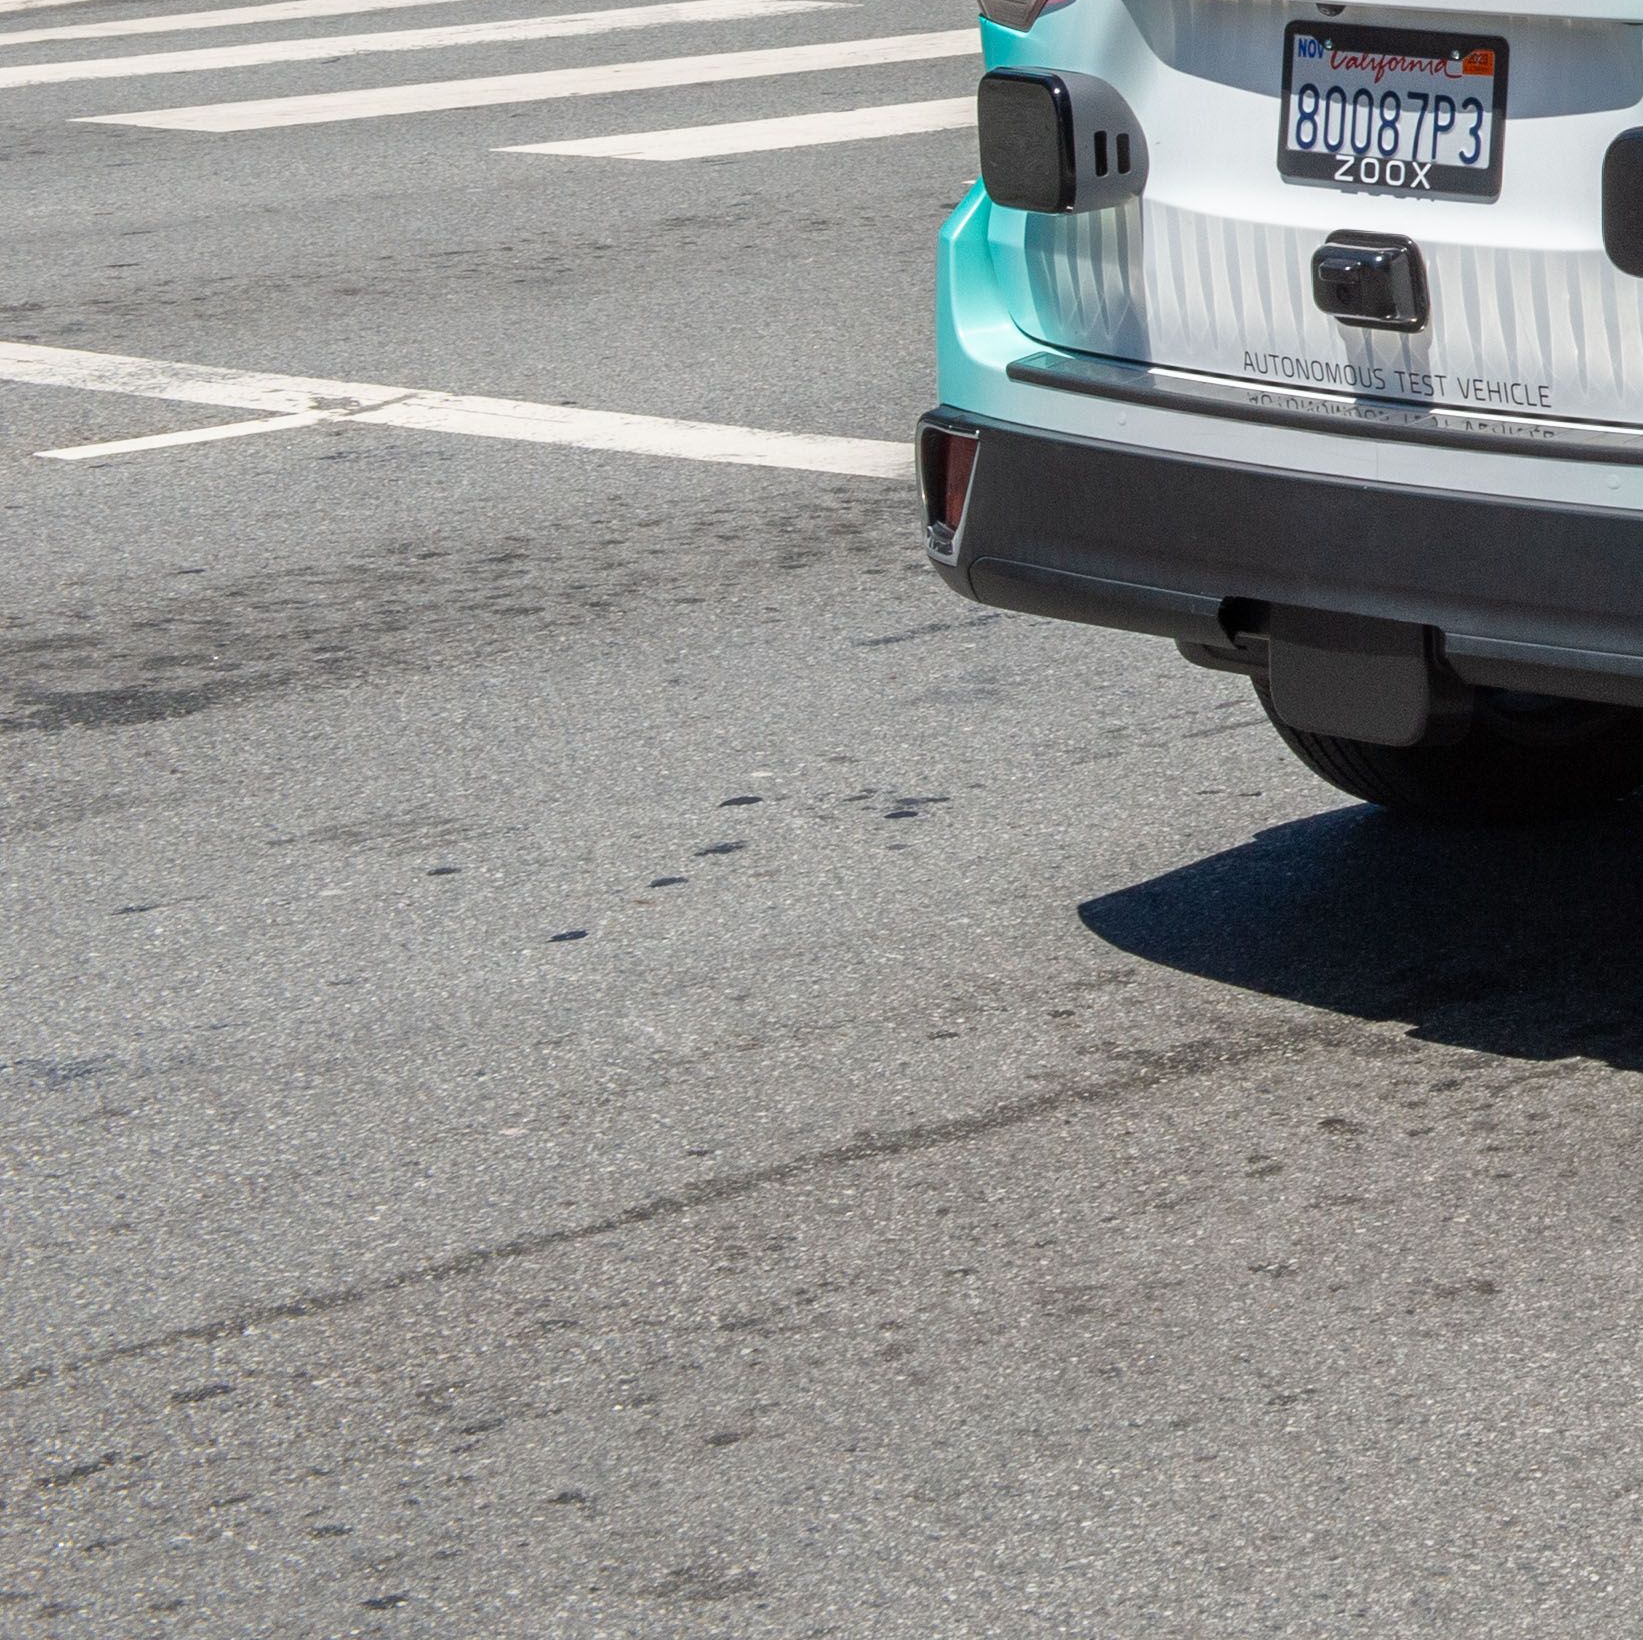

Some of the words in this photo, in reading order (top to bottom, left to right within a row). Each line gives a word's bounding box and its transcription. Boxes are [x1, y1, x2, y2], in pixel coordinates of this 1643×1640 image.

[1298, 38, 1325, 59] NOV
[1330, 47, 1463, 84] California
[1296, 83, 1484, 165] 80087P3
[1334, 155, 1432, 189] ZOOX
[1243, 350, 1387, 391] AUTONOMOUS
[1394, 370, 1448, 397] TEST
[1456, 376, 1554, 408] VEHICLE
